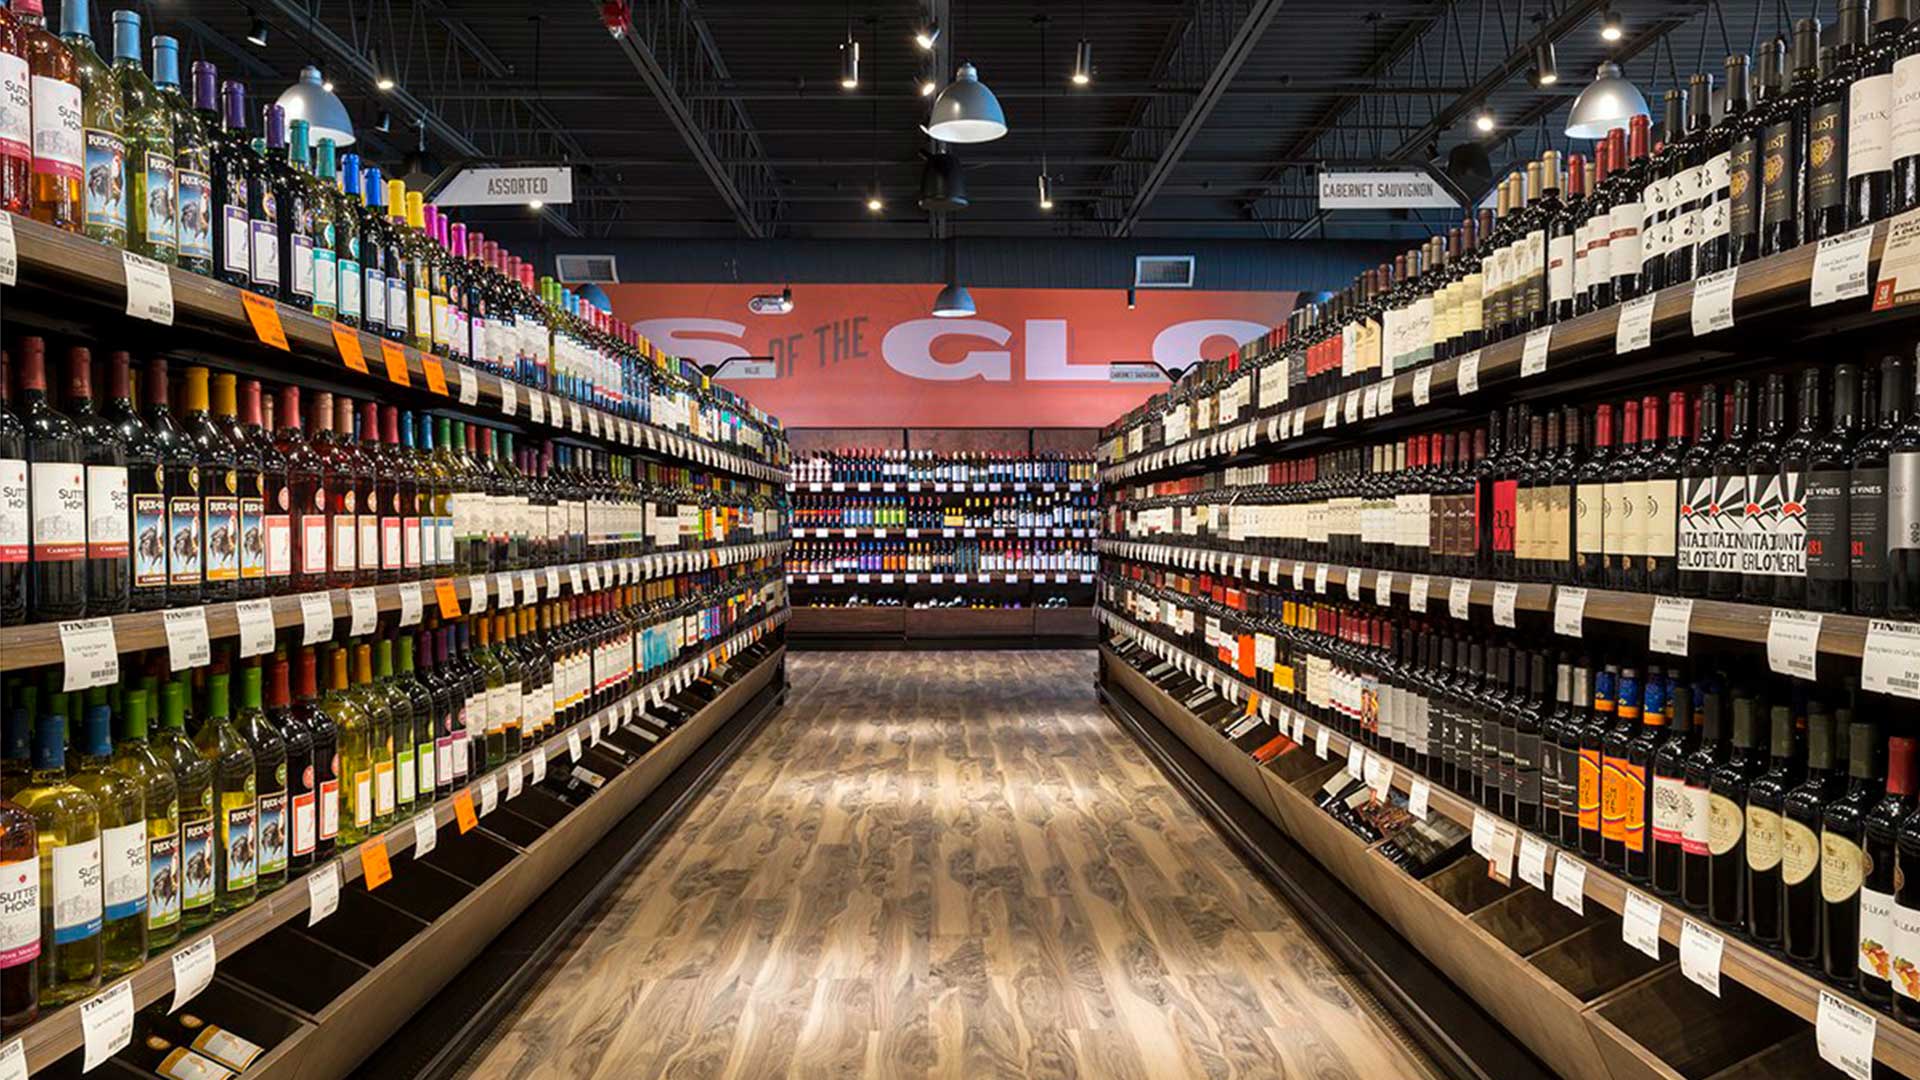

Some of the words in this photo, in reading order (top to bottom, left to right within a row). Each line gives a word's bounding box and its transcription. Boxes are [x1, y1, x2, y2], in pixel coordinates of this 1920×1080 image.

[487, 177, 549, 195] ASSORTED
[1323, 183, 1373, 198] CABERNET
[1377, 183, 1434, 198] SAUVIGNON
[768, 332, 804, 379] OF
[813, 315, 869, 369] THE
[1816, 487, 1841, 496] VINES
[1857, 485, 1883, 495] VINES
